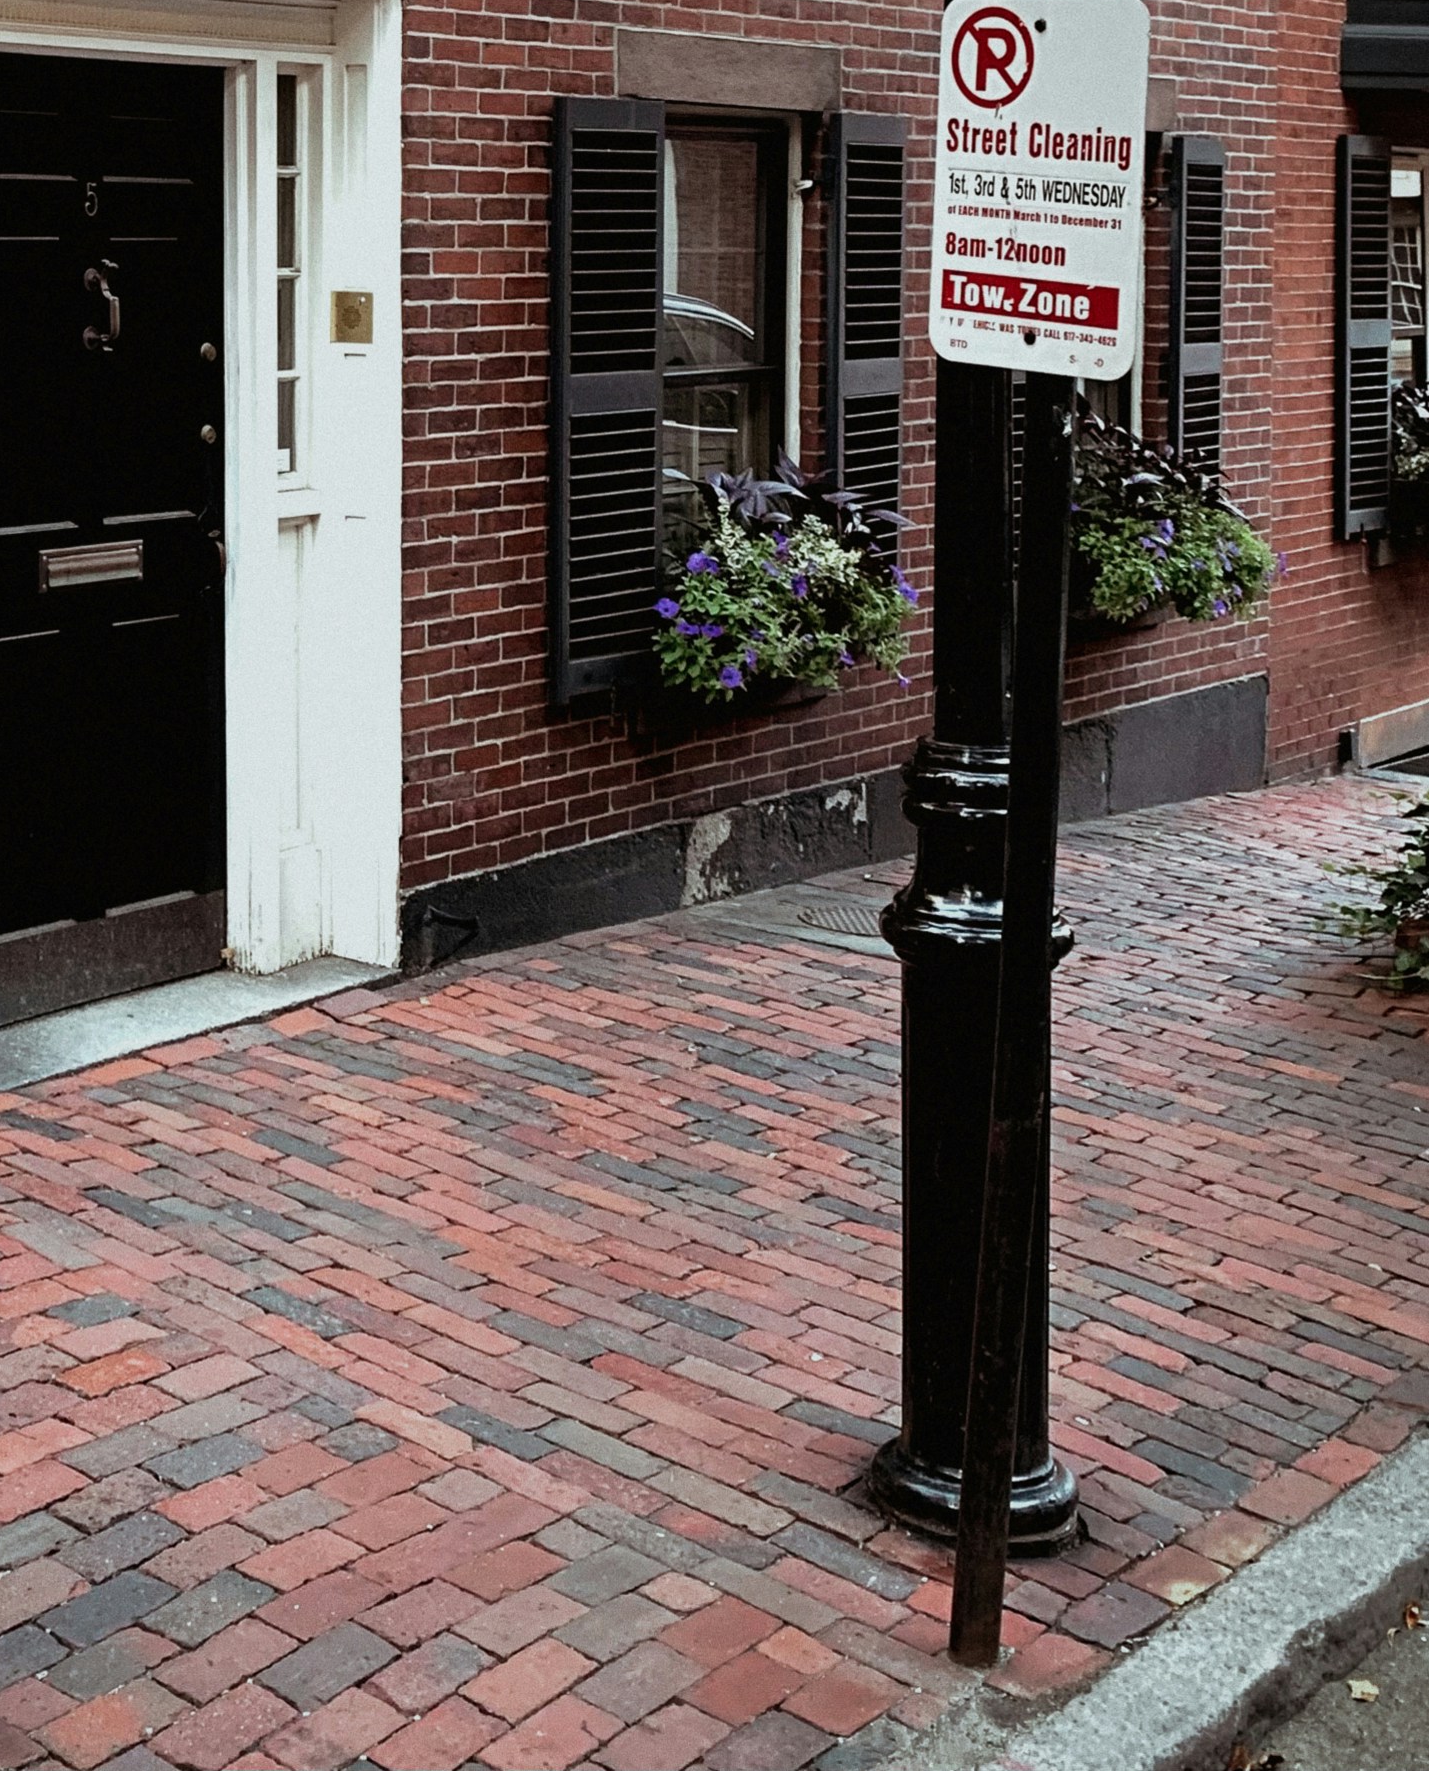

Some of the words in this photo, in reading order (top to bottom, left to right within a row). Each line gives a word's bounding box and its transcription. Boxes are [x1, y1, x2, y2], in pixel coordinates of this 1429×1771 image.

[946, 117, 1018, 157] Street
[1028, 121, 1132, 171] Cleaning
[85, 182, 98, 216] 5
[948, 172, 969, 198] 1st,
[974, 174, 995, 198] 3rd
[1000, 176, 1010, 200] &
[1015, 178, 1037, 201] 5th
[1042, 179, 1126, 209] WEDNESDAY
[958, 205, 979, 217] EACH
[981, 207, 1011, 219] MONTH
[1013, 209, 1041, 222] March
[1050, 214, 1059, 224] to
[1061, 214, 1109, 229] December
[1110, 218, 1122, 230] 31
[948, 274, 1006, 310] Tow
[1018, 282, 1091, 320] Zone
